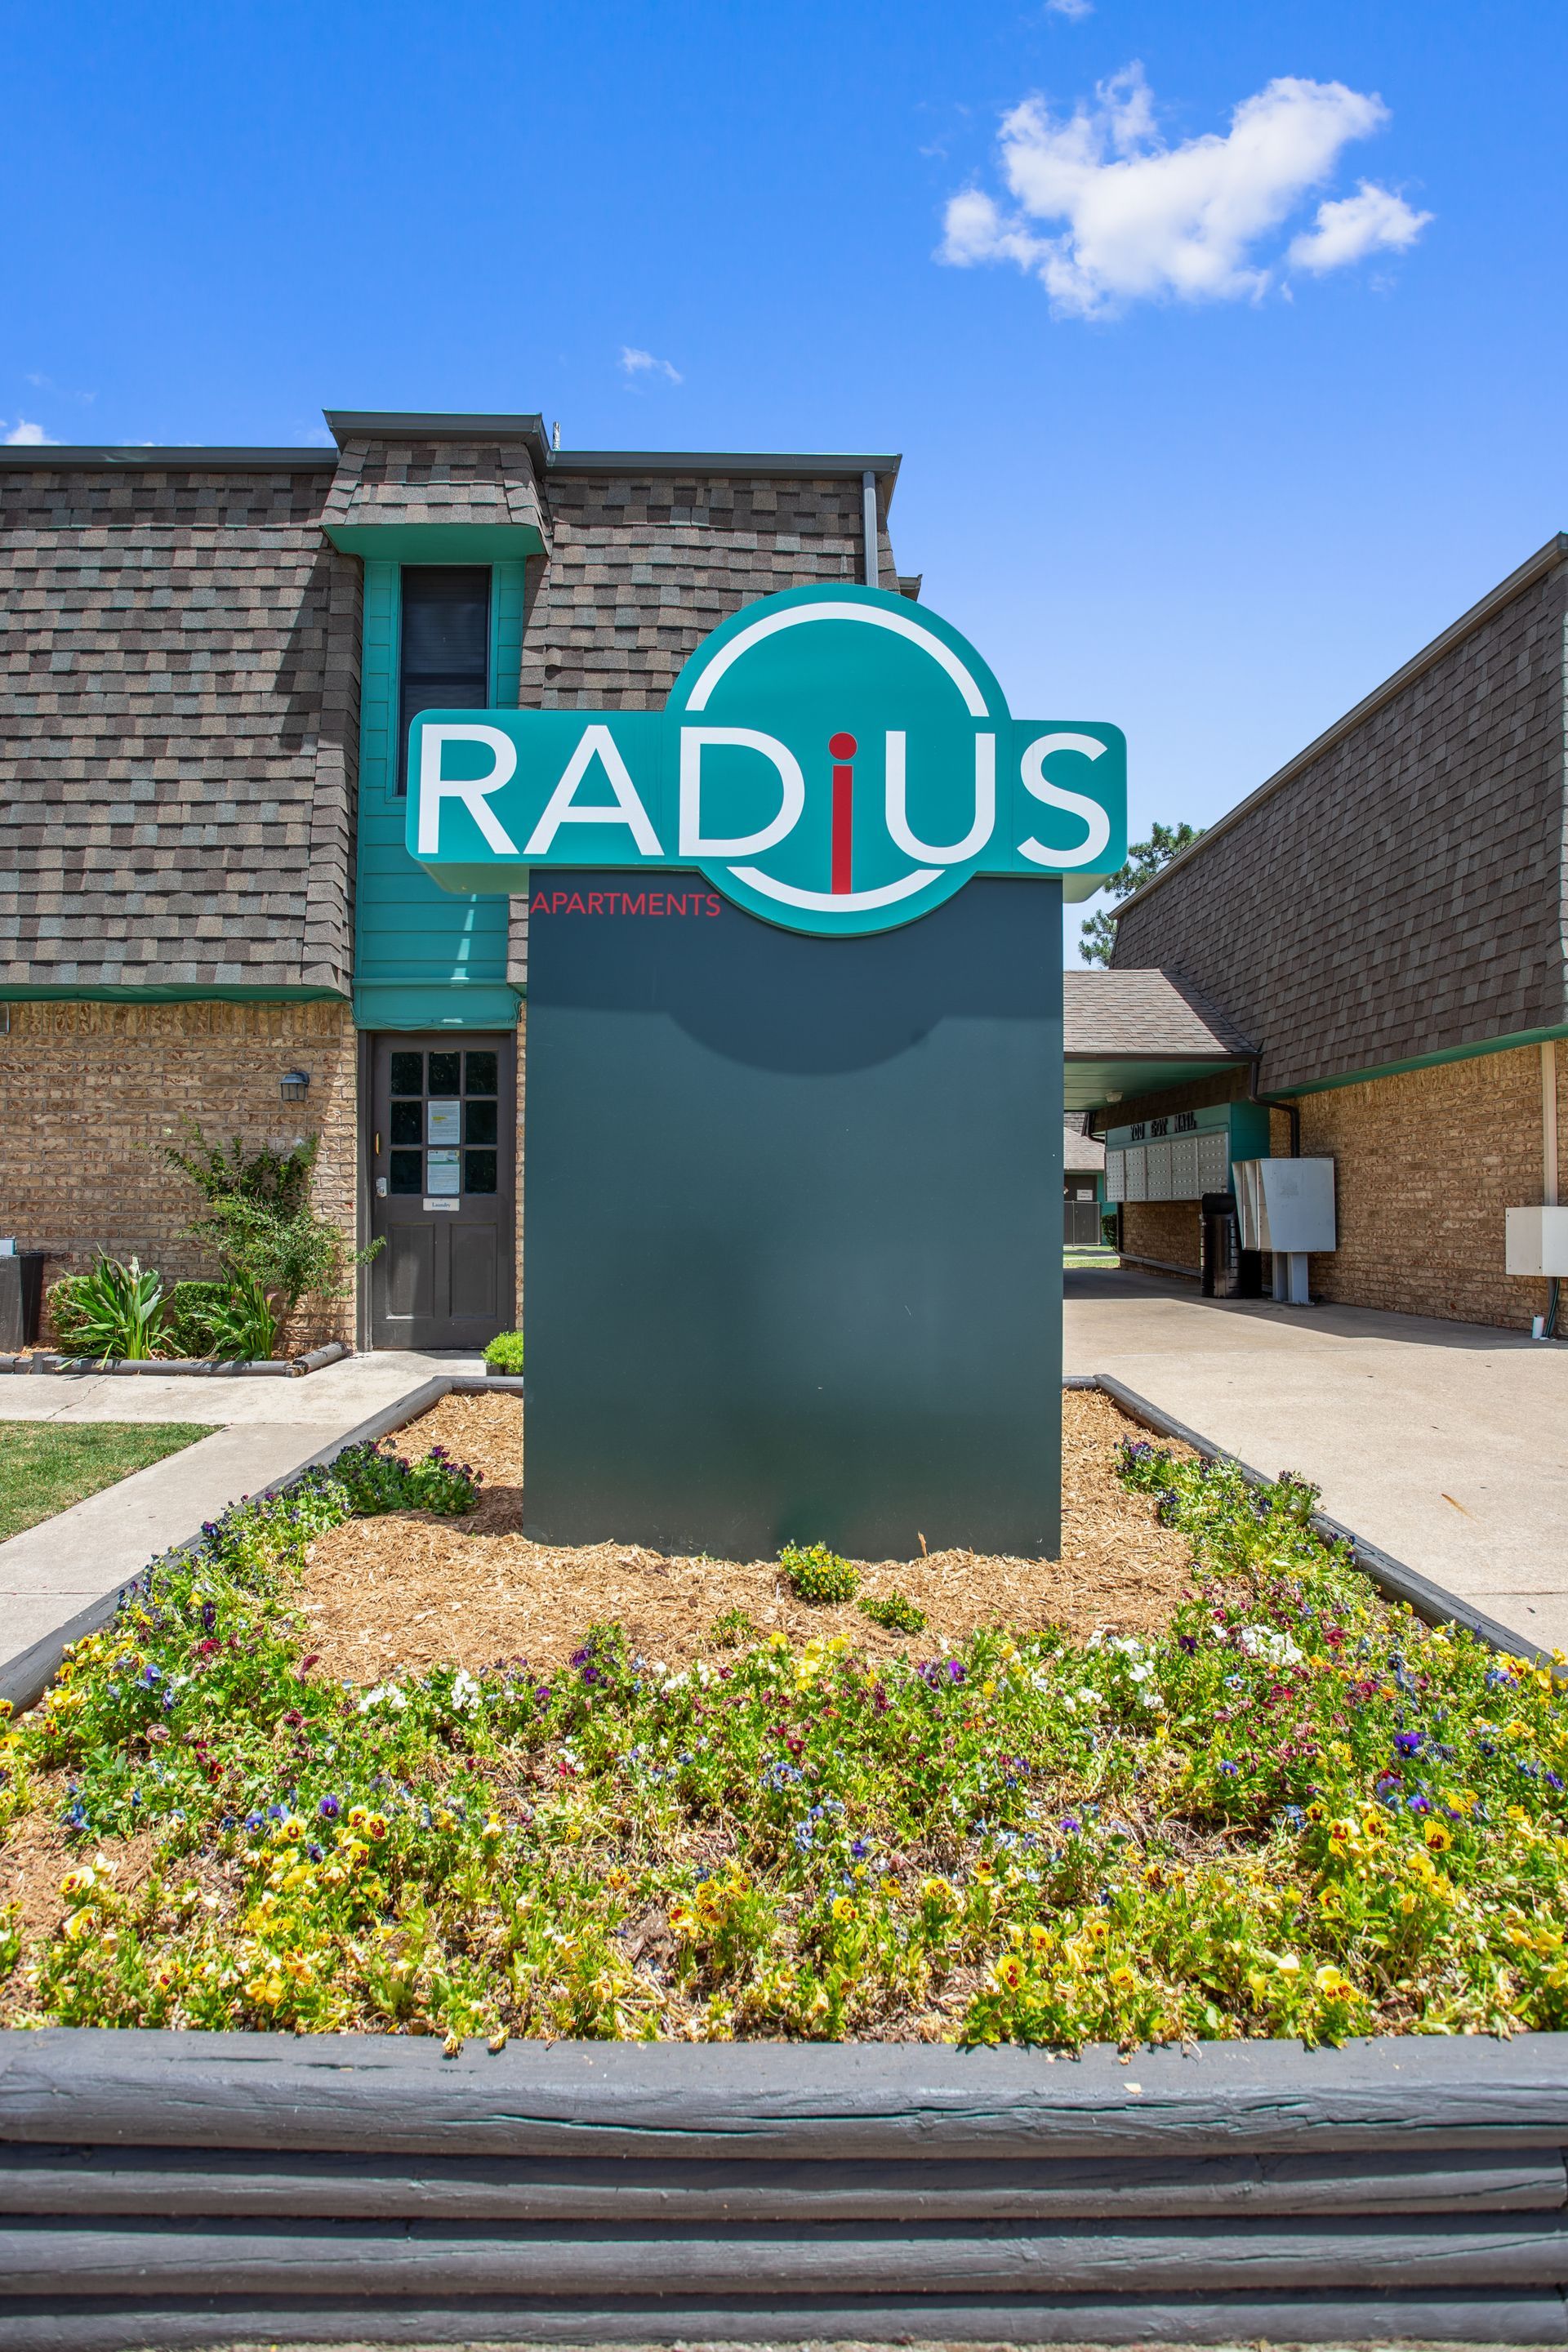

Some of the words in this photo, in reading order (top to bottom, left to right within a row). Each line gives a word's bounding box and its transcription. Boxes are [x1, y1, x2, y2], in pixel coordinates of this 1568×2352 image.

[418, 724, 1110, 895] RADiUS
[530, 892, 721, 917] APARTMENTS
[1130, 1123, 1145, 1141] YOU
